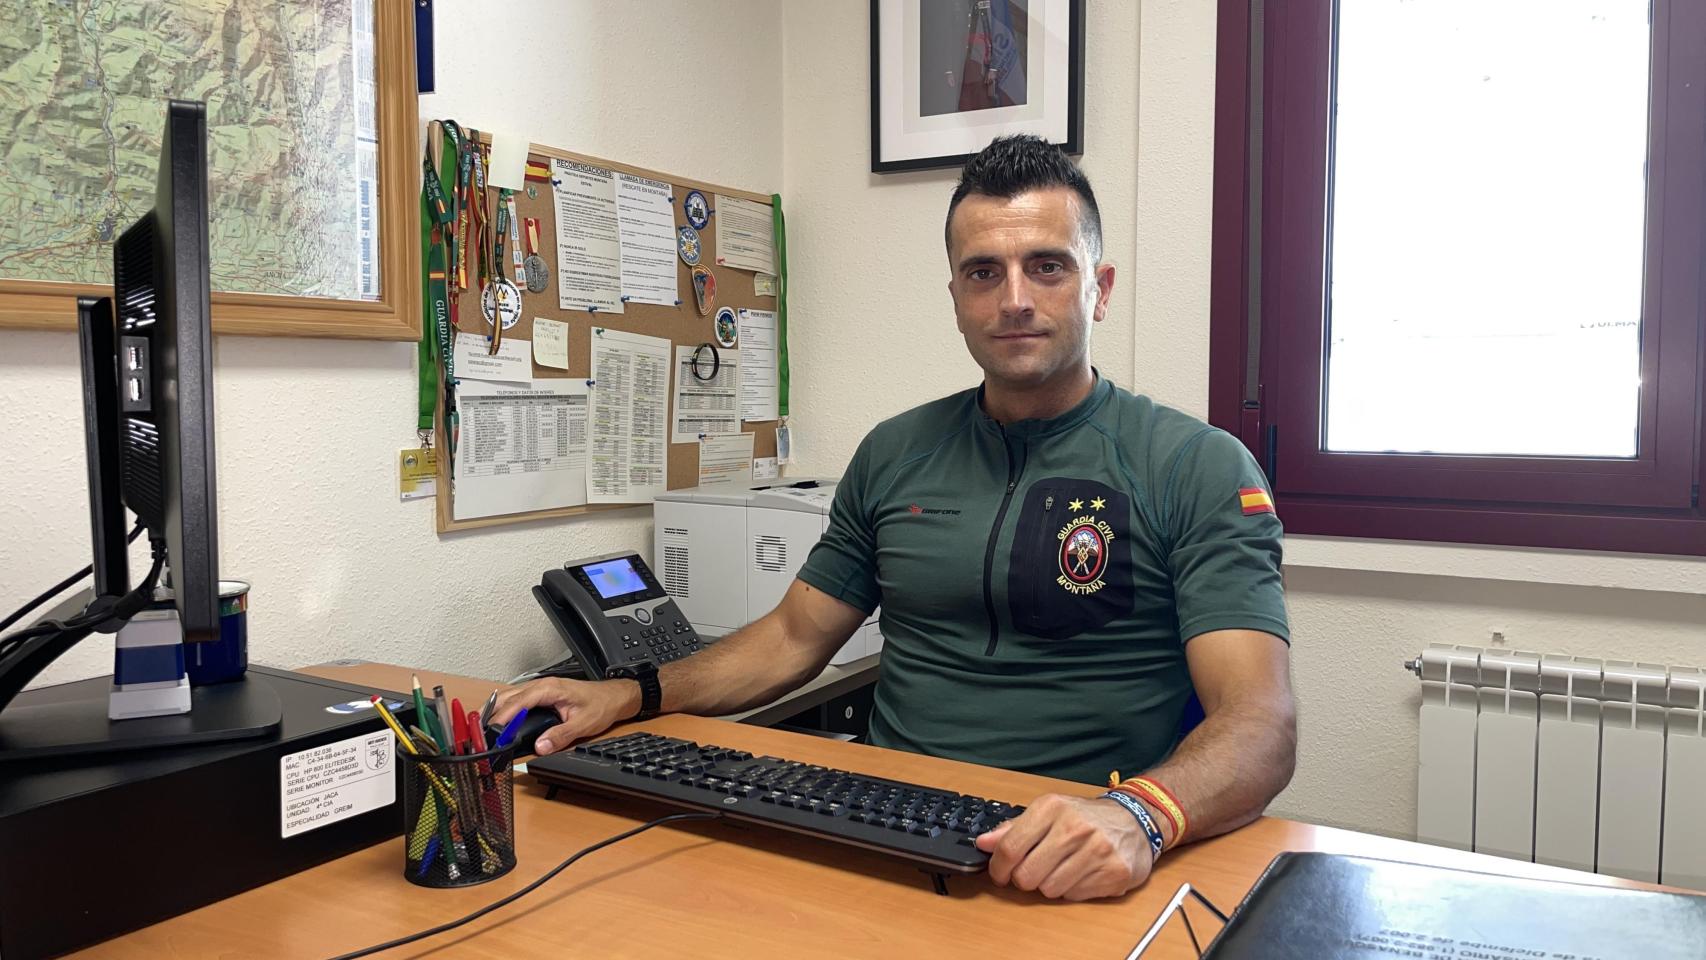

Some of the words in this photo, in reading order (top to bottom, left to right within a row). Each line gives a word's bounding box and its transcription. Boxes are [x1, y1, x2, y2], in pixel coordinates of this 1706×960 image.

[435, 299, 448, 345] GUARDIA
[1057, 515, 1095, 540] GUARDIA
[1097, 520, 1115, 544] CIVIL
[286, 762, 300, 770] MAC
[325, 756, 356, 769] ELITEDESK
[286, 786, 304, 795] SERIE
[305, 778, 333, 790] MONITOR
[287, 778, 305, 787] SERIE
[306, 774, 320, 782] CPU
[323, 792, 339, 800] JACA
[286, 807, 310, 818] UNIDAD
[286, 811, 330, 829] ESPECIALIDAD
[334, 804, 353, 814] GREIM
[1341, 940, 1423, 957] BENASQU
